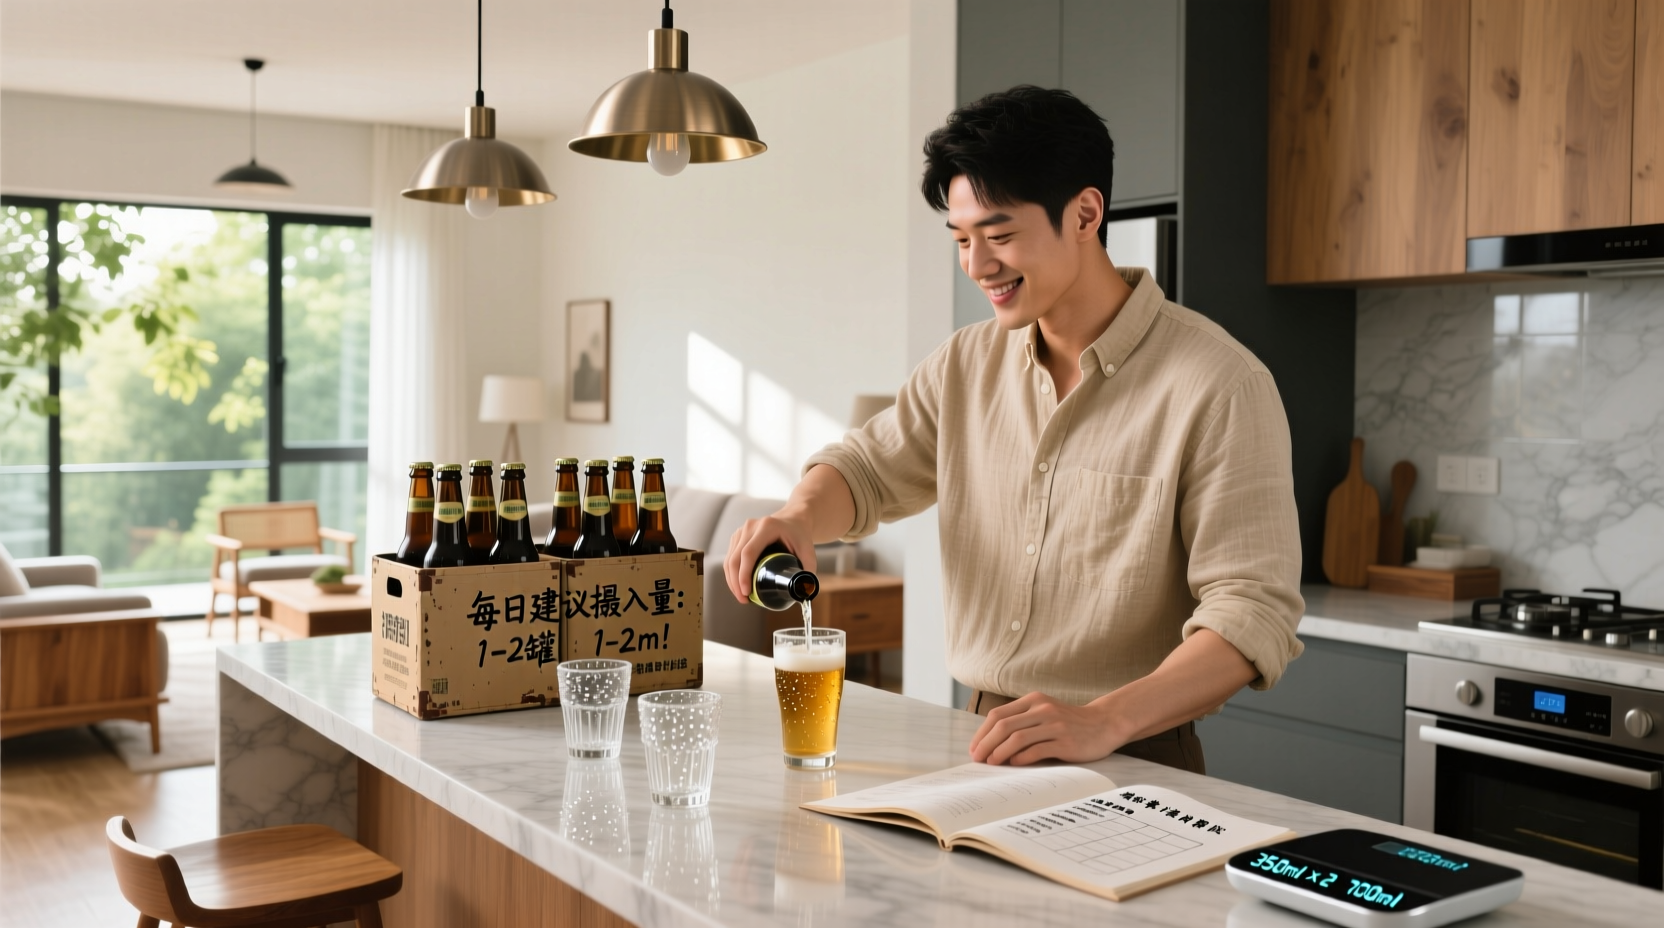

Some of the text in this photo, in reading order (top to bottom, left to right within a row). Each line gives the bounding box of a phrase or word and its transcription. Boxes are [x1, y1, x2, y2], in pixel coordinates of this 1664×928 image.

[478, 629, 557, 669] 1-2罐
[1250, 852, 1308, 879] 350ml
[1347, 878, 1404, 908] 700ml
